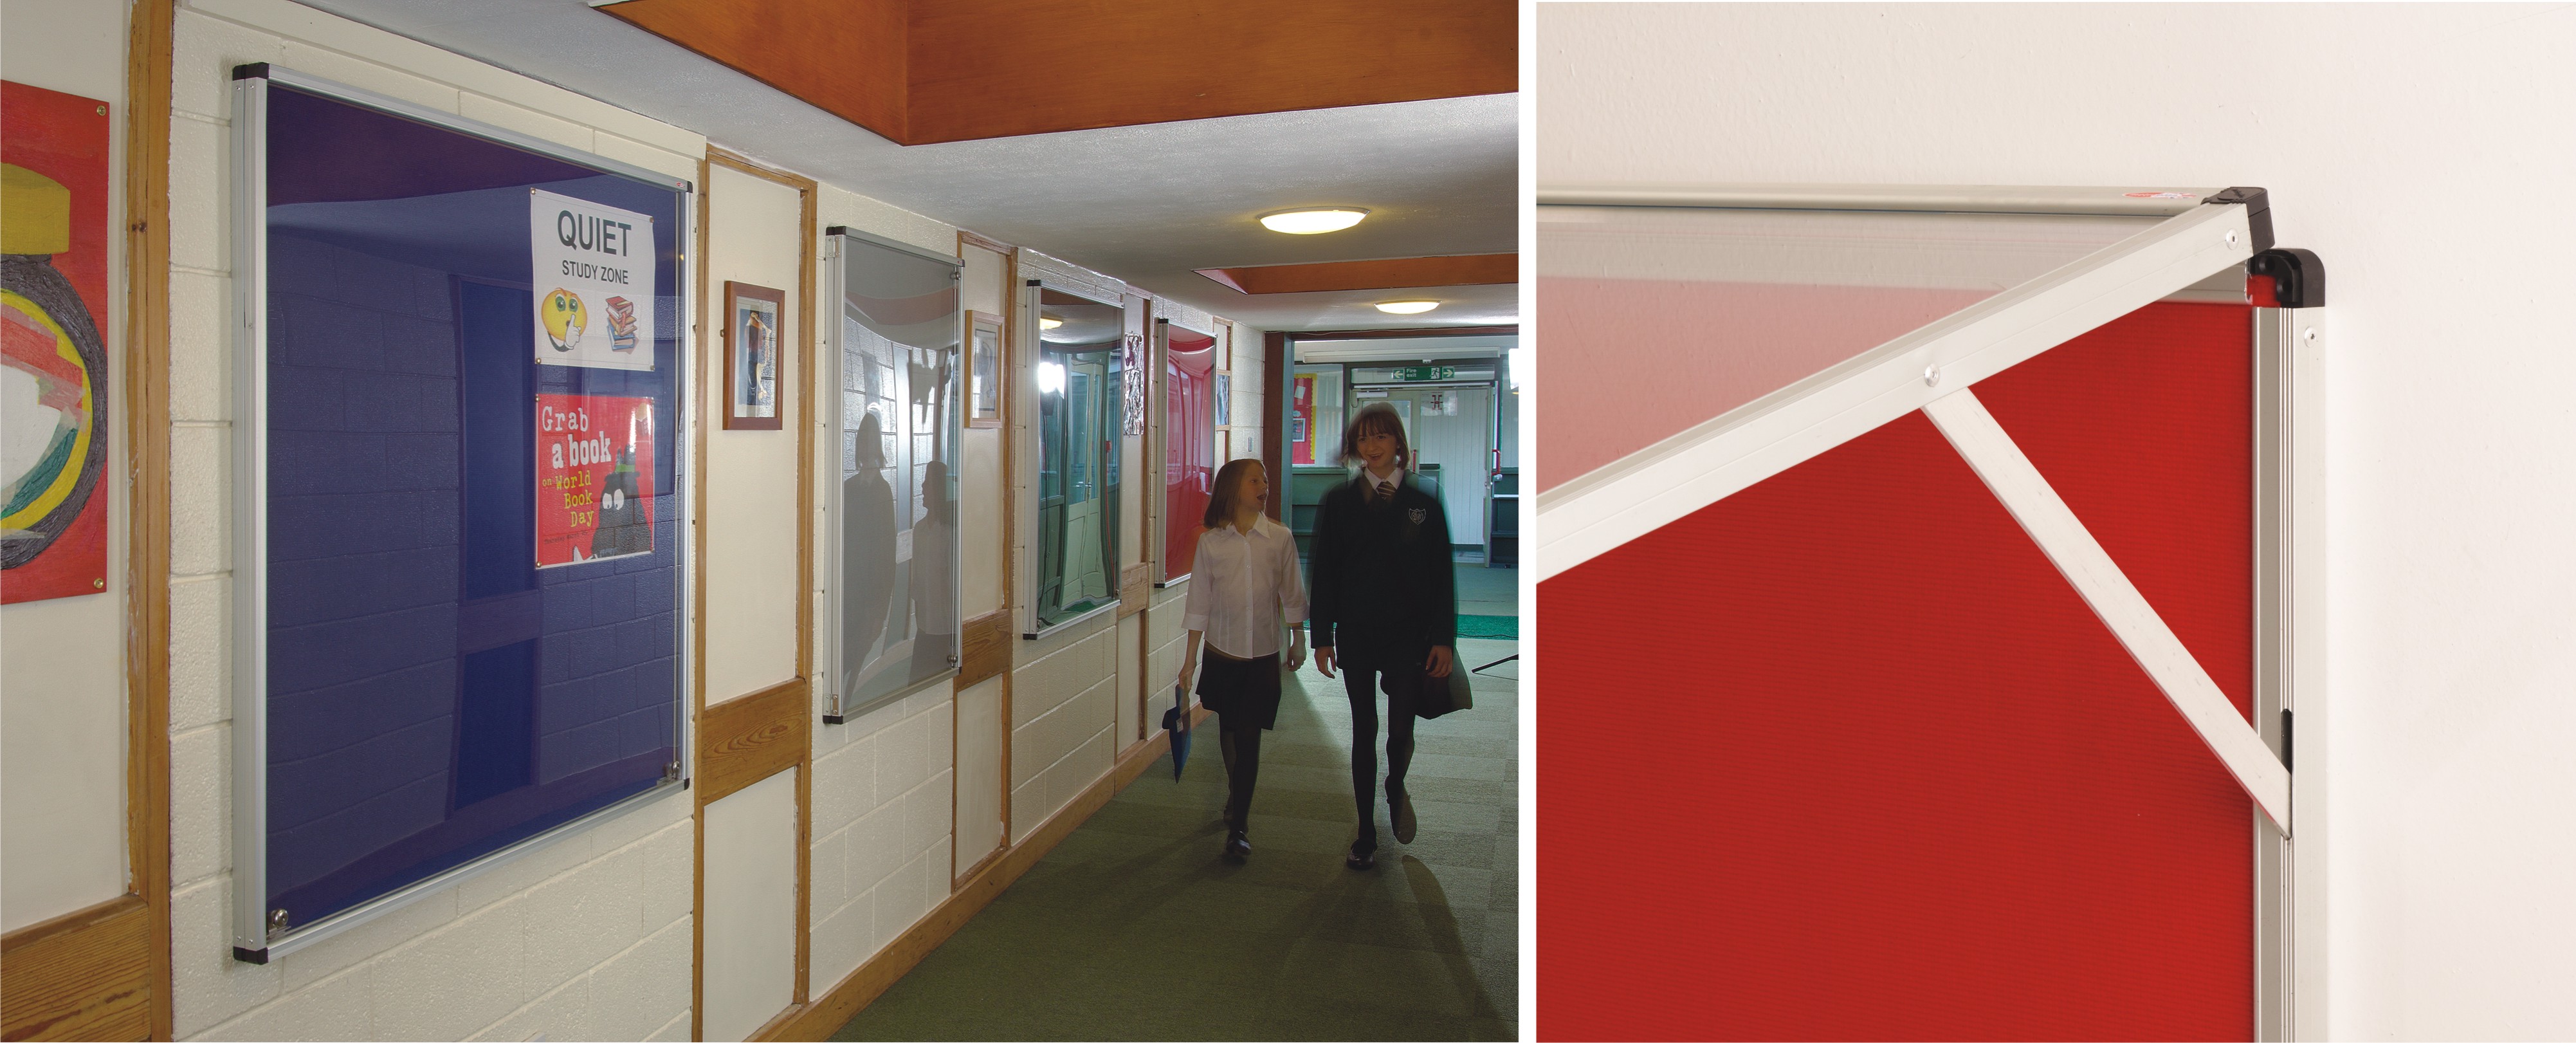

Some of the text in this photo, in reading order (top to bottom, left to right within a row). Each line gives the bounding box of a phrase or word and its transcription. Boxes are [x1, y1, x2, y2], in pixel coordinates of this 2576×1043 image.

[557, 210, 632, 257] QUIET
[562, 260, 628, 284] STUDY ZONE
[542, 406, 589, 432] Grab
[552, 431, 612, 469] a book
[542, 470, 592, 490] on World
[564, 490, 593, 509] Book
[571, 510, 594, 527] Day
